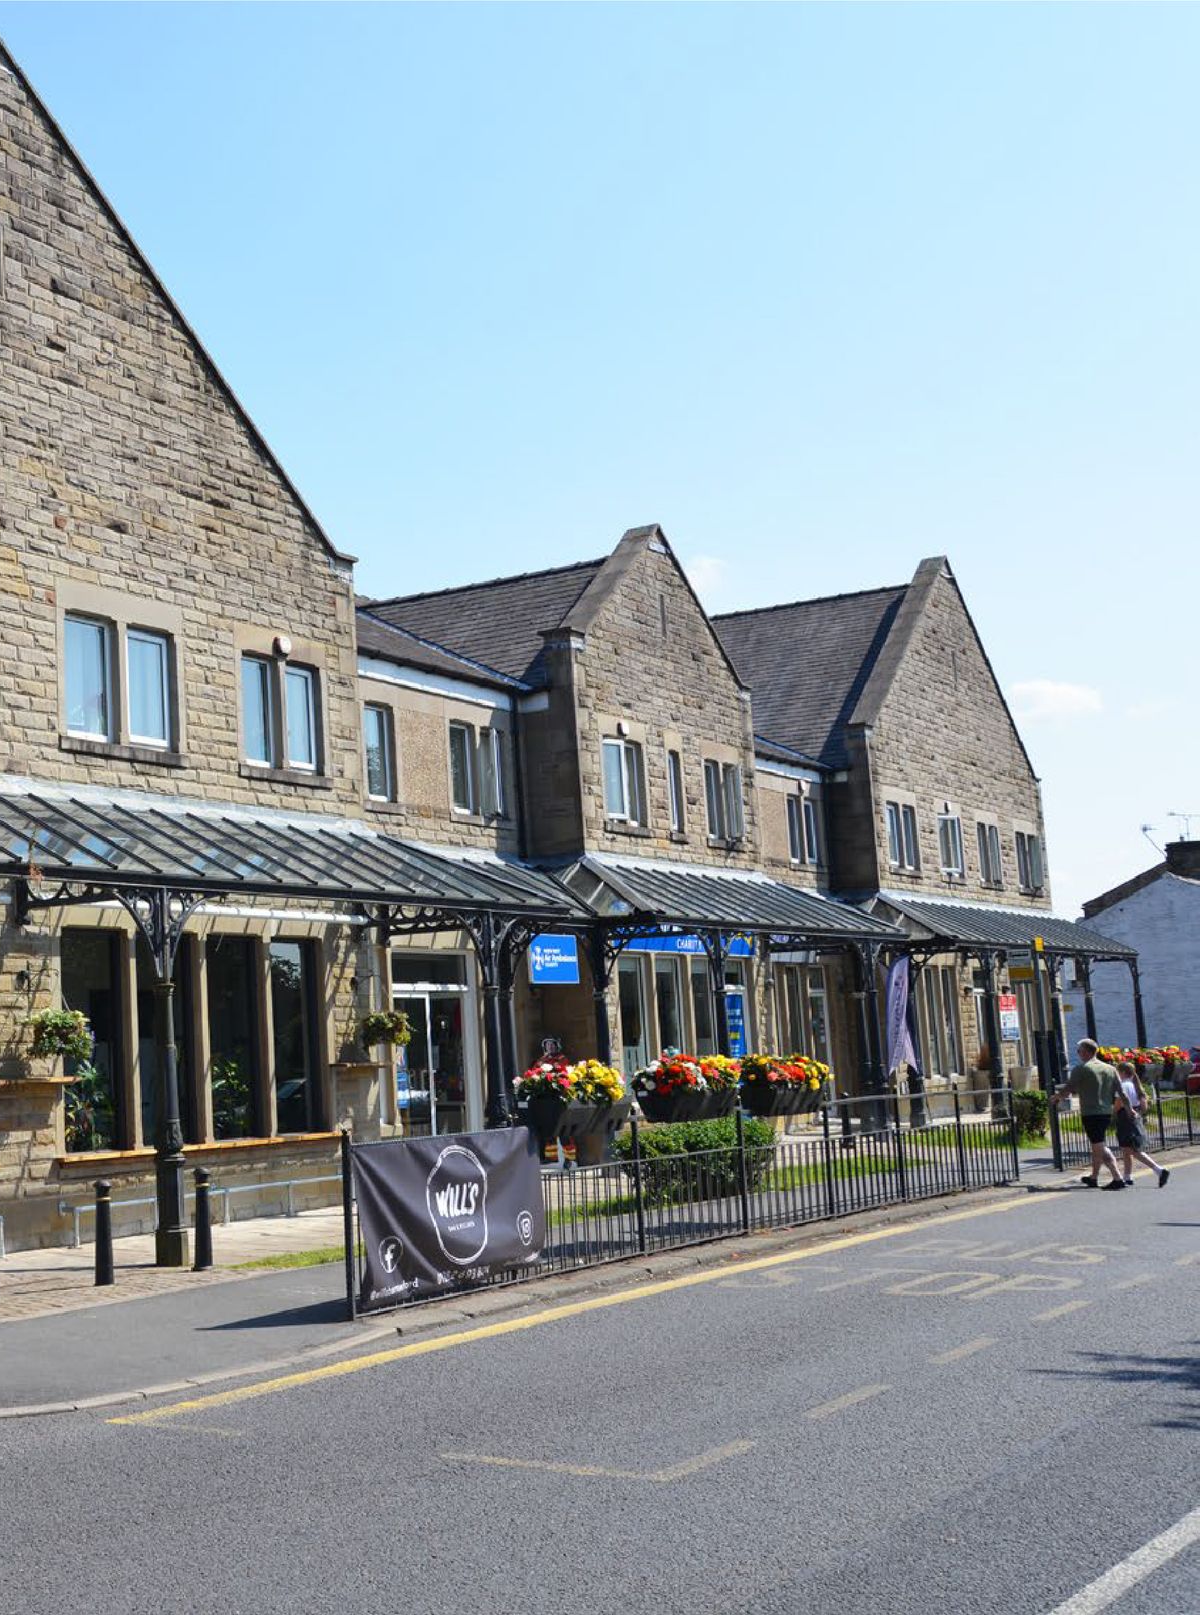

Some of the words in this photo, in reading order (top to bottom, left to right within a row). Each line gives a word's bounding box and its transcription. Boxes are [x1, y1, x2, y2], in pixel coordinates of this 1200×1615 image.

[435, 1182, 479, 1218] WILL'S
[877, 1239, 1129, 1265] BUS
[716, 1266, 1083, 1299] STOP
